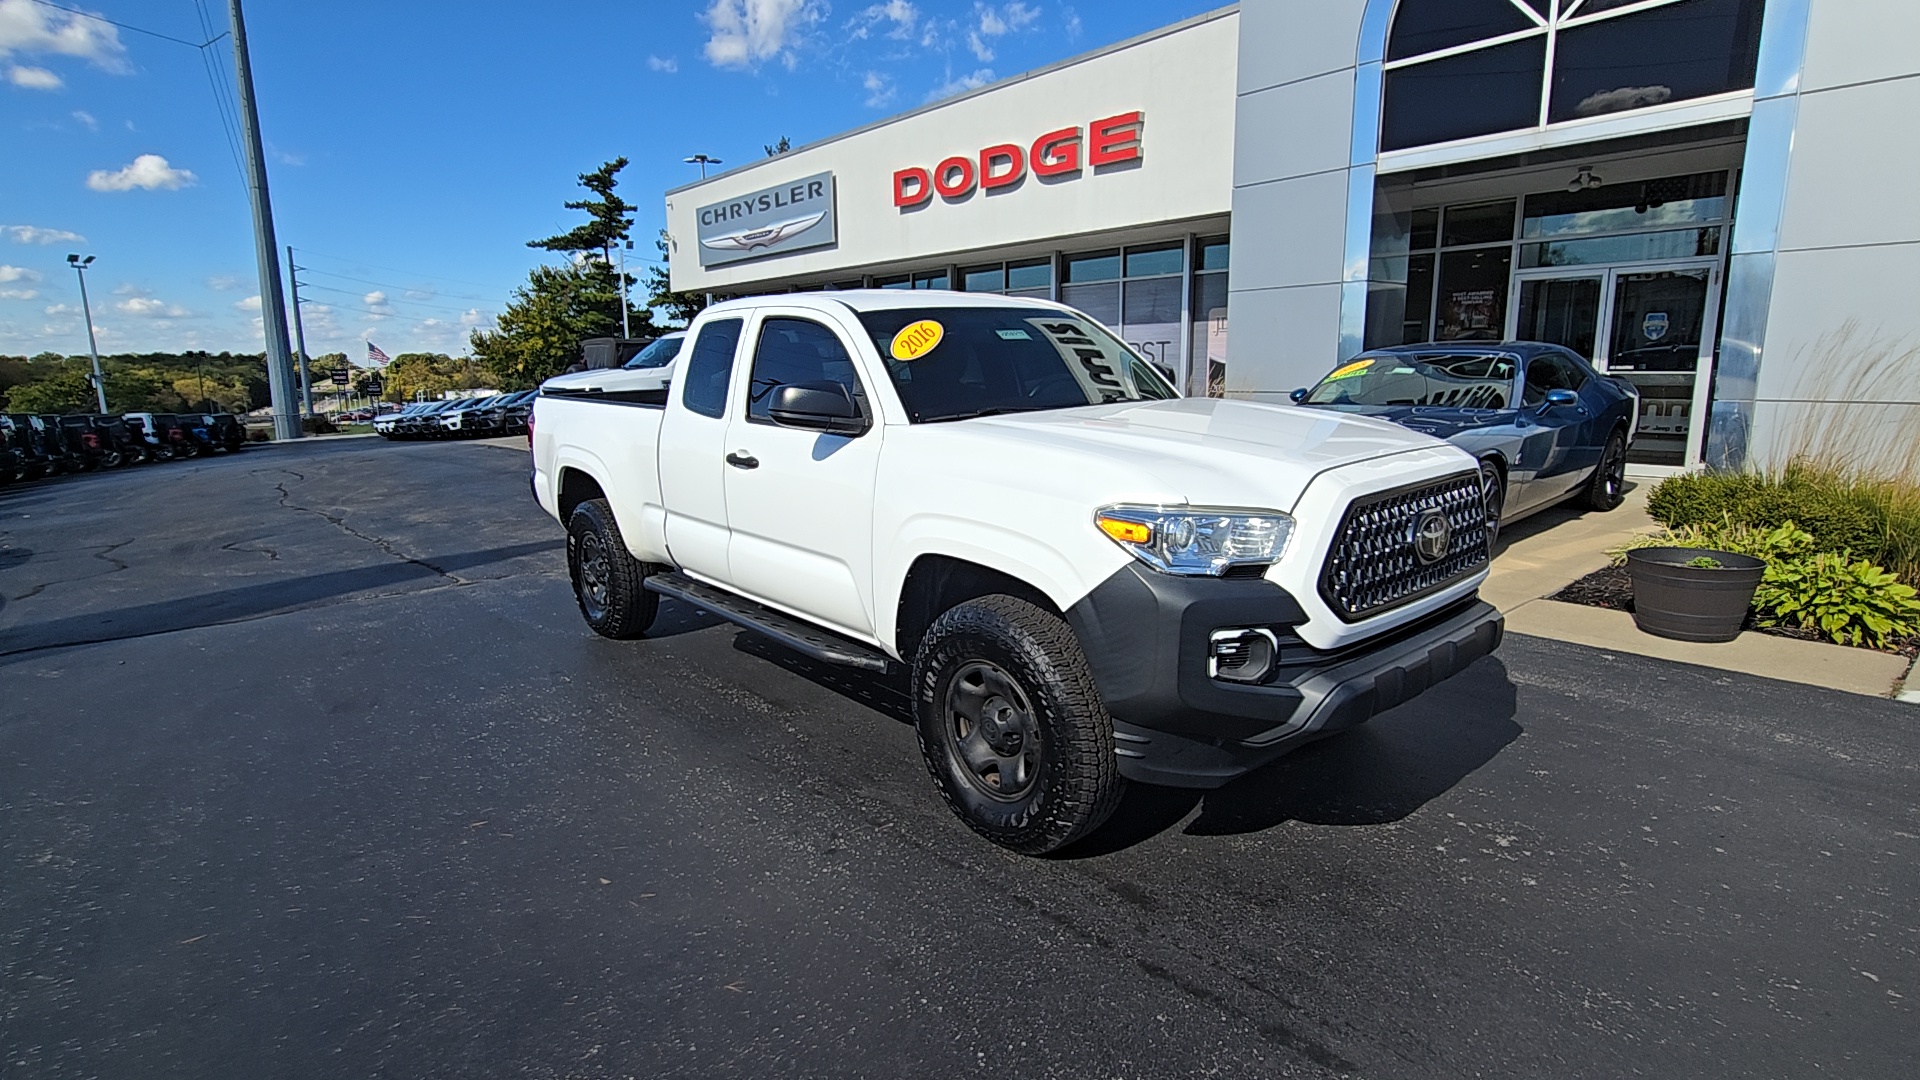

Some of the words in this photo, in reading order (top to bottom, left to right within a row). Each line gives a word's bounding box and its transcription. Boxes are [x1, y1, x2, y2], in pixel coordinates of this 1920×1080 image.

[893, 111, 1144, 210] DODGE
[701, 180, 824, 226] CHRYSLER
[900, 321, 936, 356] 2016
[922, 637, 987, 704] WRANGLE
